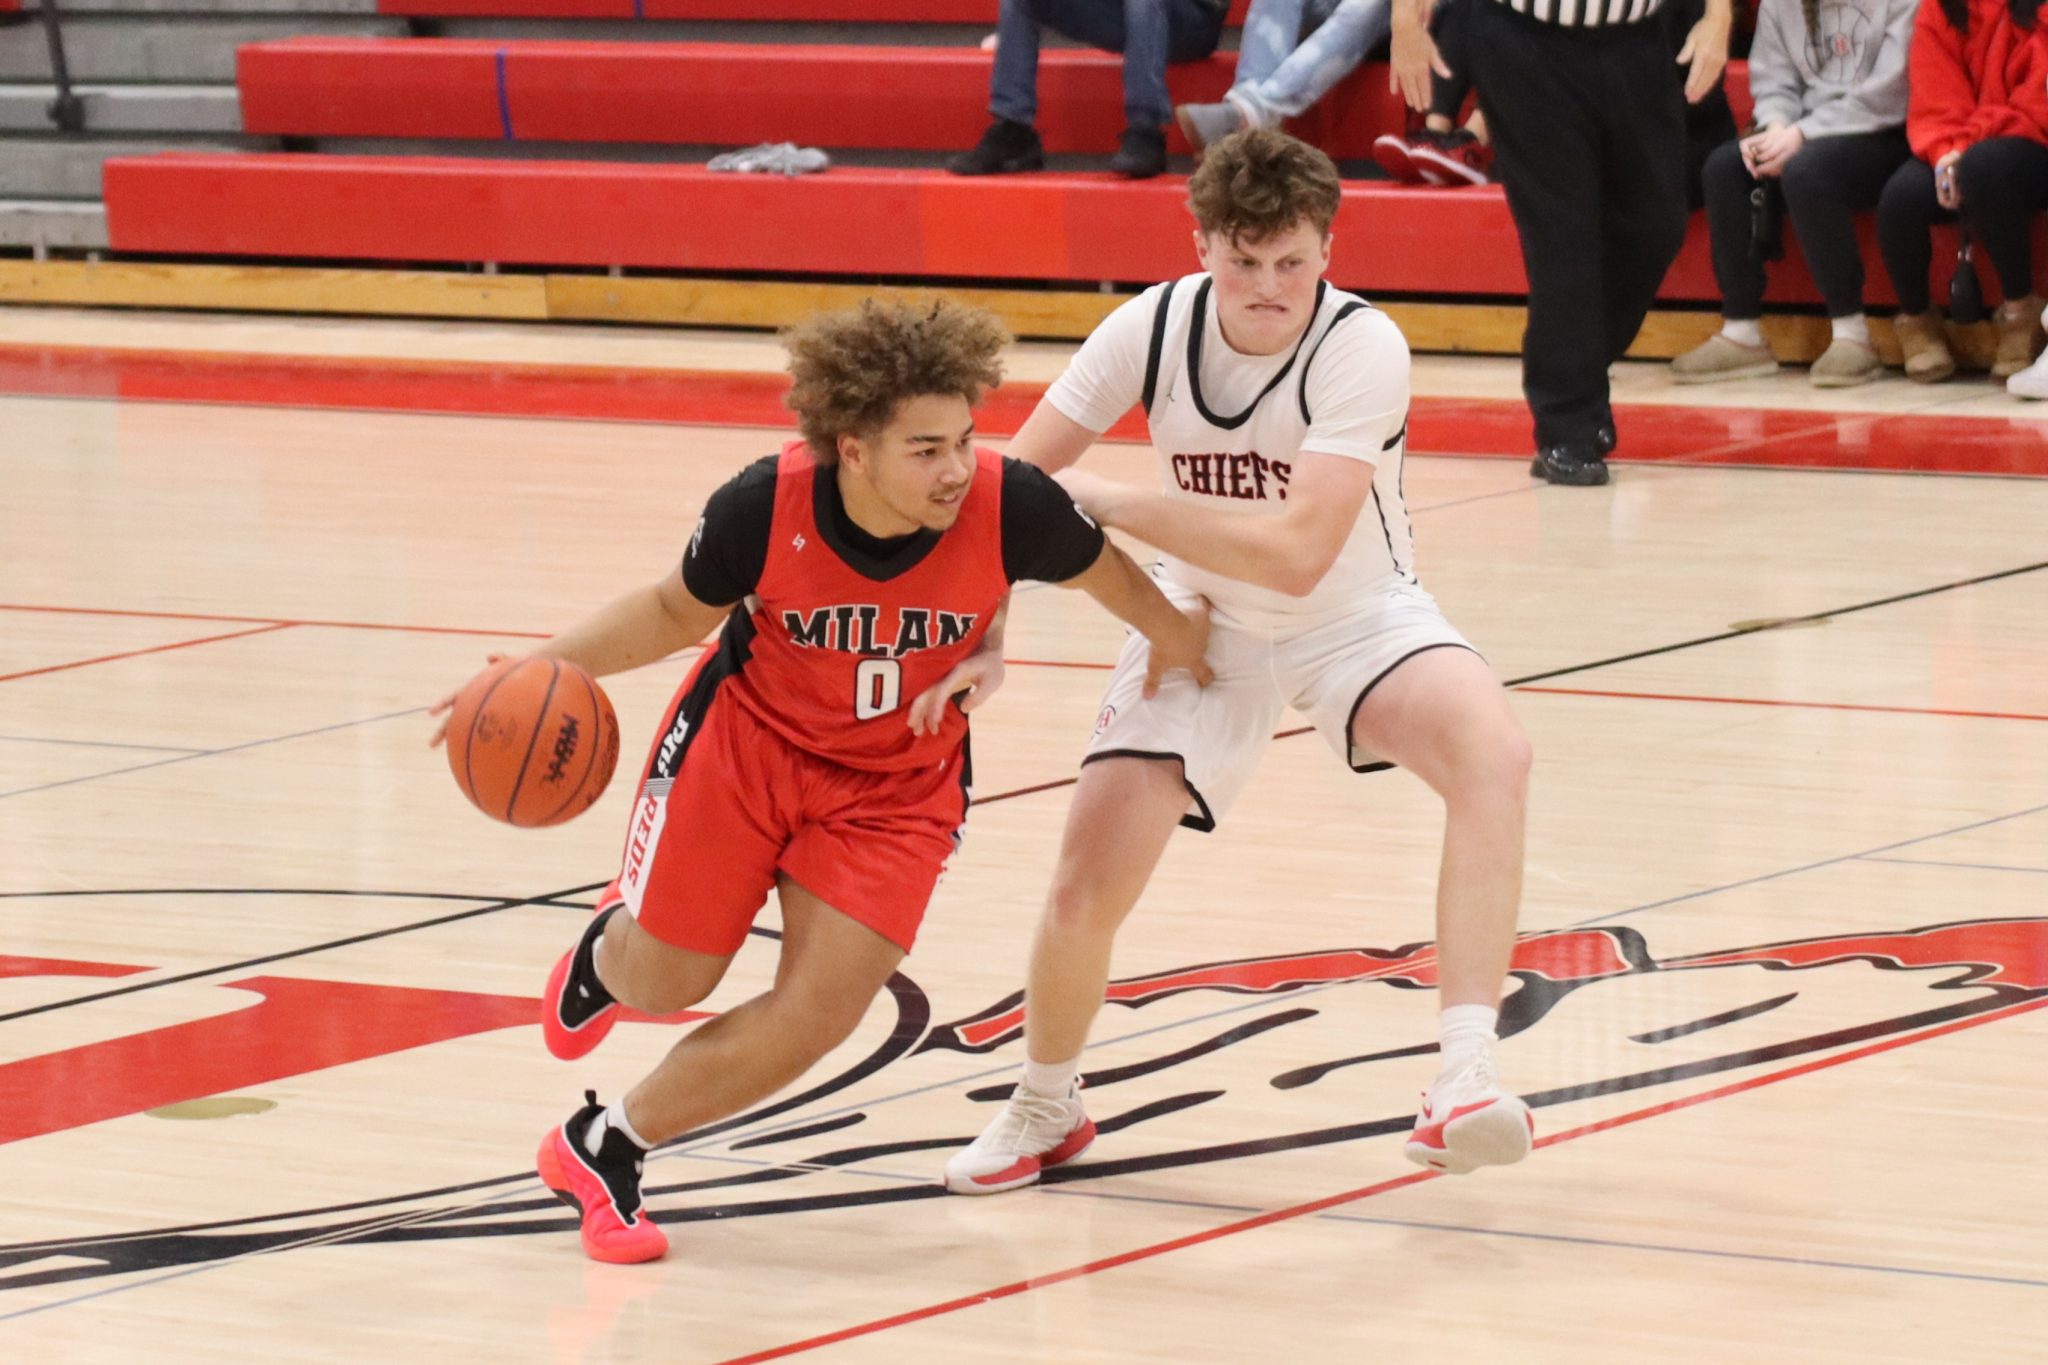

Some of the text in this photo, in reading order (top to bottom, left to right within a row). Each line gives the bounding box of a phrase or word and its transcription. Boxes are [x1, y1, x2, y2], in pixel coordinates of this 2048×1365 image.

[1171, 451, 1291, 500] CHIEFS
[782, 604, 978, 658] MILAN
[855, 657, 902, 720] 0
[628, 792, 658, 888] REDS
